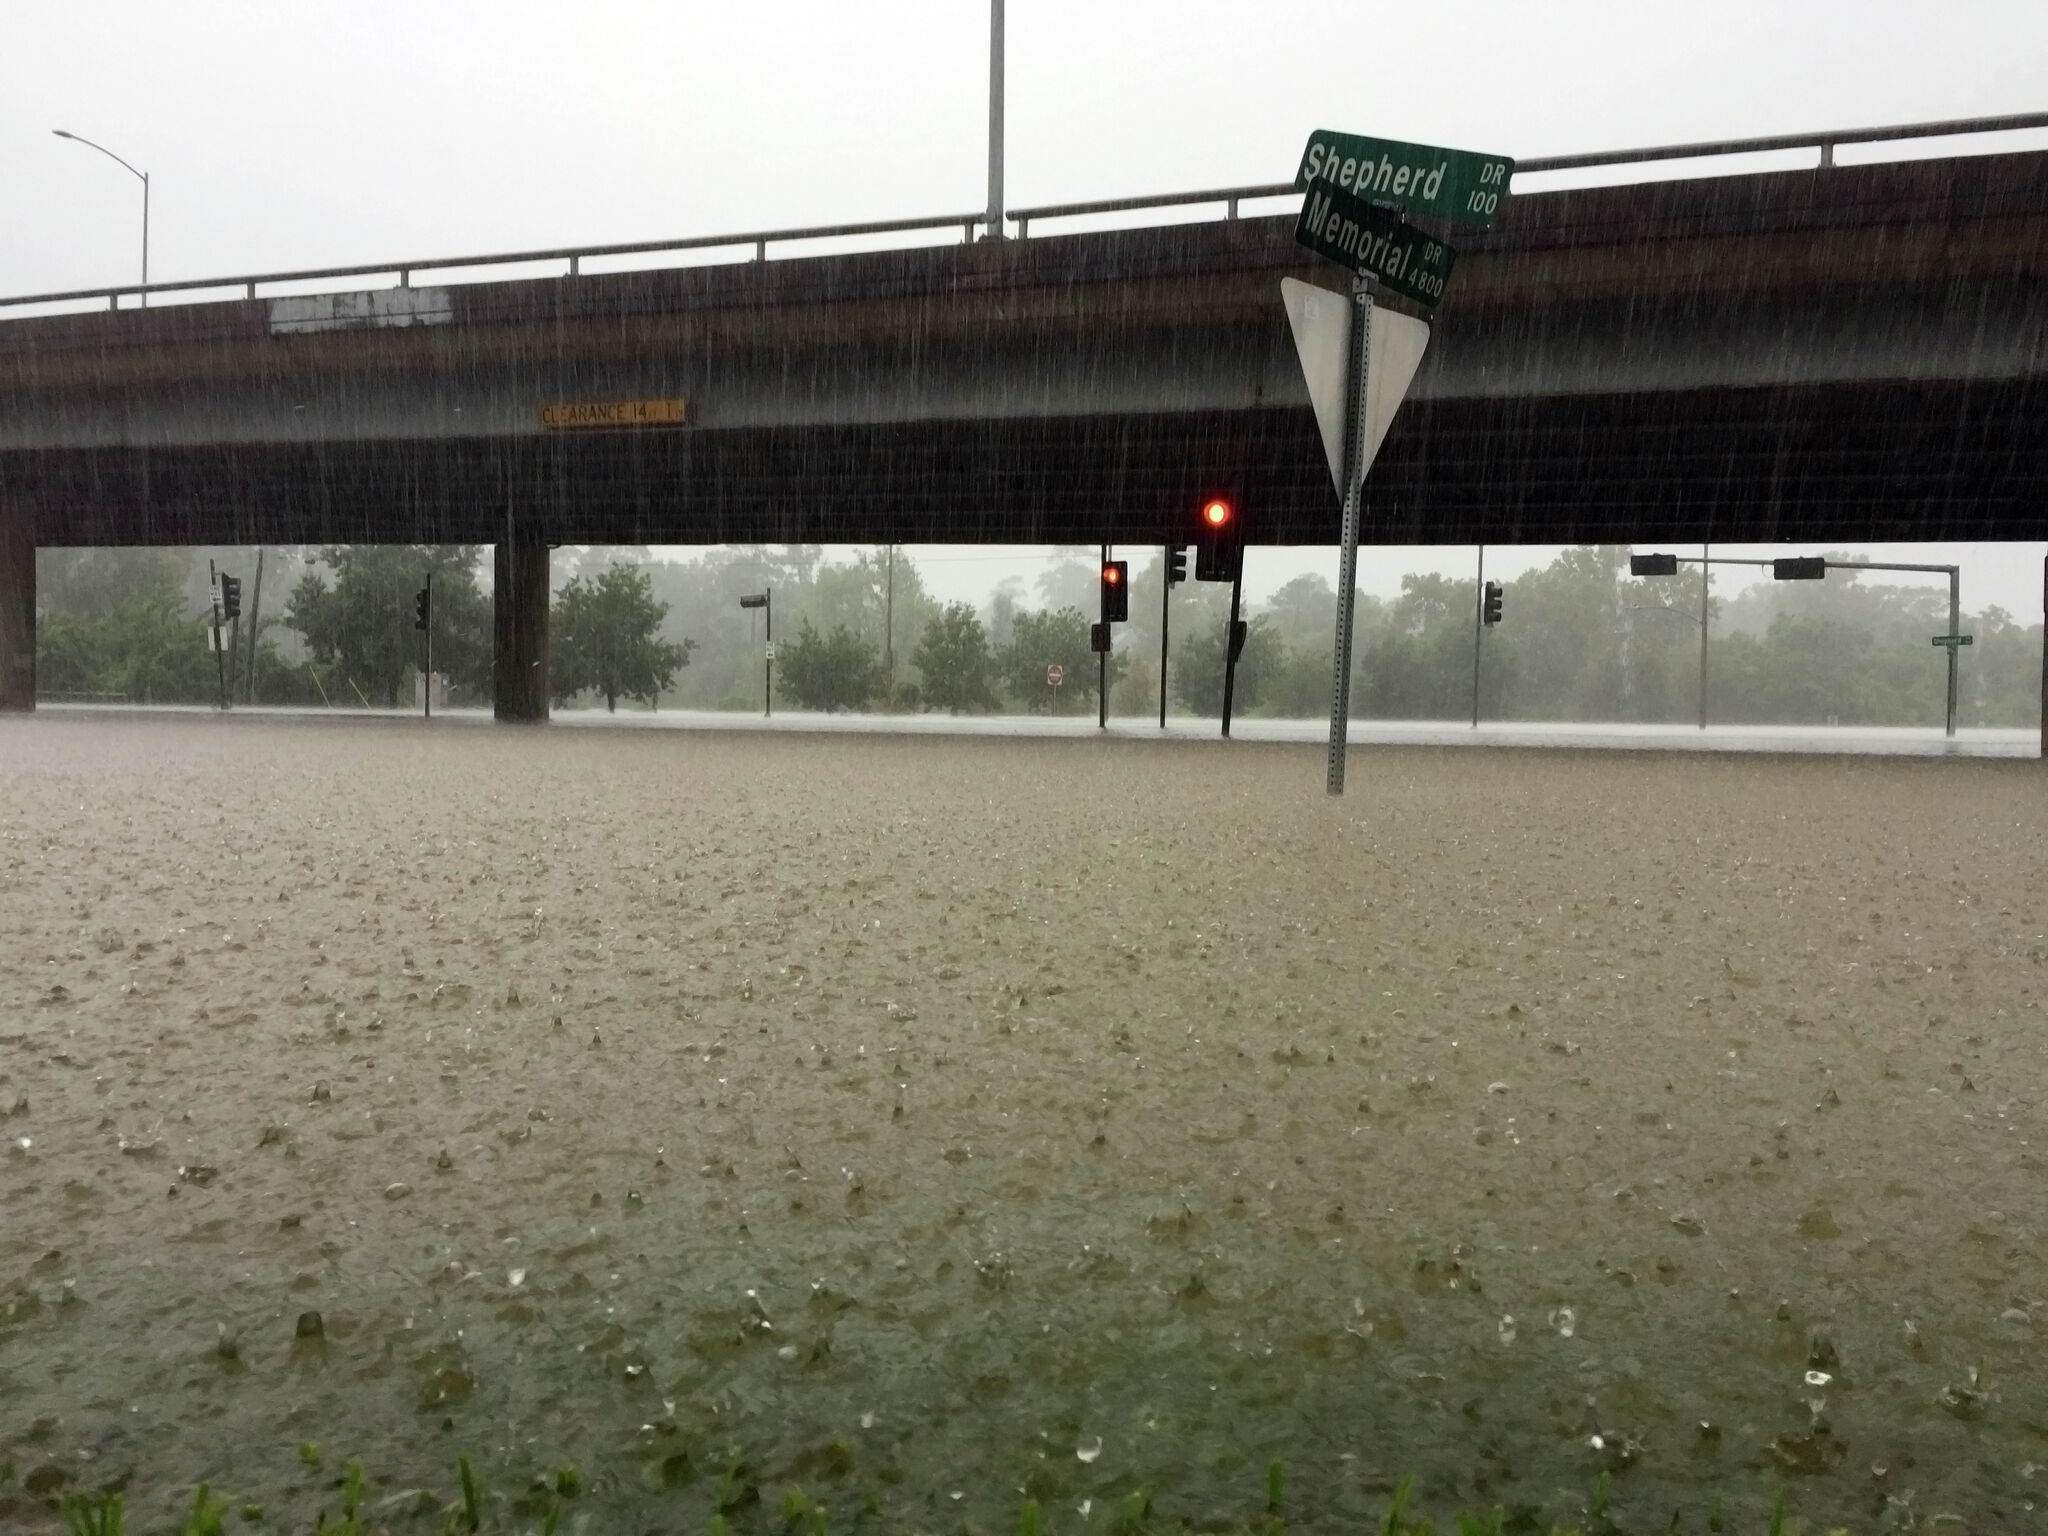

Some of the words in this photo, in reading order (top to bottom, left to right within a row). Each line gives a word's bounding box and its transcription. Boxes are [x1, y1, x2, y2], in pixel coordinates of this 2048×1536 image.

[1304, 143, 1447, 200] Shepherd
[1480, 162, 1506, 186] DR
[1466, 190, 1498, 215] 100
[1305, 191, 1413, 280] Memorial
[1424, 241, 1442, 265] DR
[1408, 267, 1444, 298] 4800
[633, 403, 647, 419] 14
